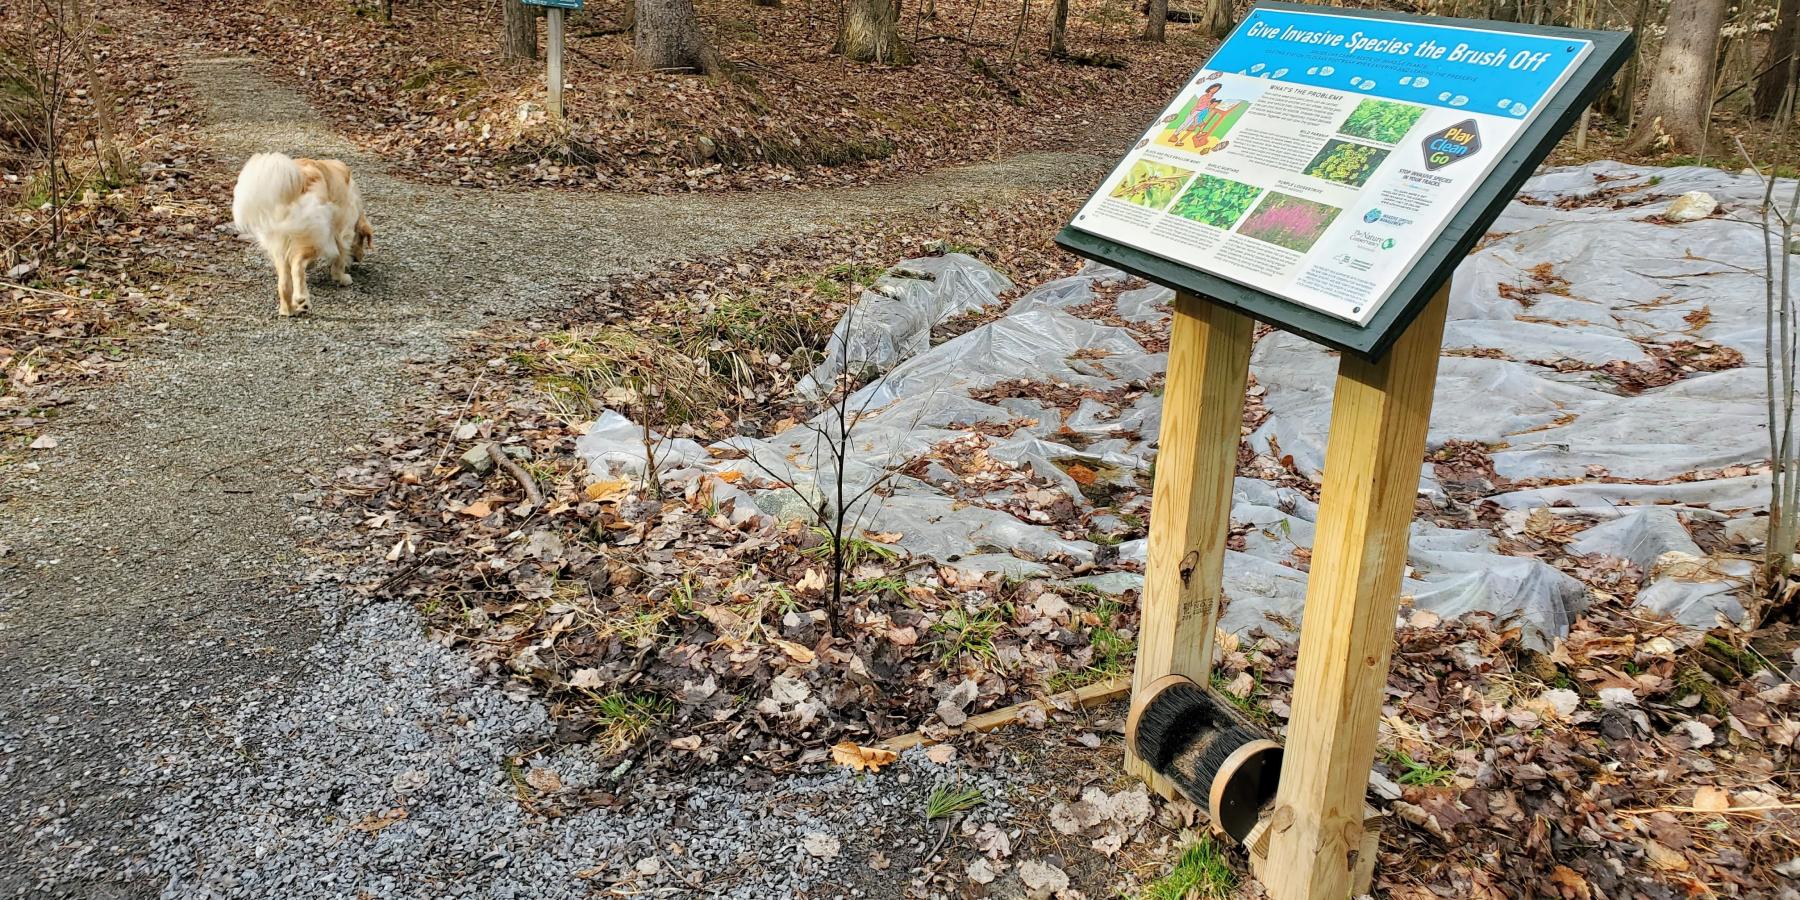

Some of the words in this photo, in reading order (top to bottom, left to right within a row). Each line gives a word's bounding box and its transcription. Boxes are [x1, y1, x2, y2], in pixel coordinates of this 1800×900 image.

[1247, 21, 1280, 39] Give
[1280, 24, 1345, 47] Invasive
[1345, 31, 1413, 55] Species
[1414, 40, 1447, 59] the
[1447, 43, 1508, 67] Brush
[1508, 50, 1552, 72] Off
[1269, 84, 1294, 94] WHAT'S
[1294, 88, 1308, 96] THE
[1308, 90, 1344, 101] PROBLEM?
[1444, 127, 1476, 146] Play
[1430, 138, 1468, 155] Clean
[1429, 152, 1450, 165] Go
[1411, 170, 1434, 180] INVASIVE
[1434, 175, 1454, 184] SPECIES
[1361, 231, 1384, 243] Nature
